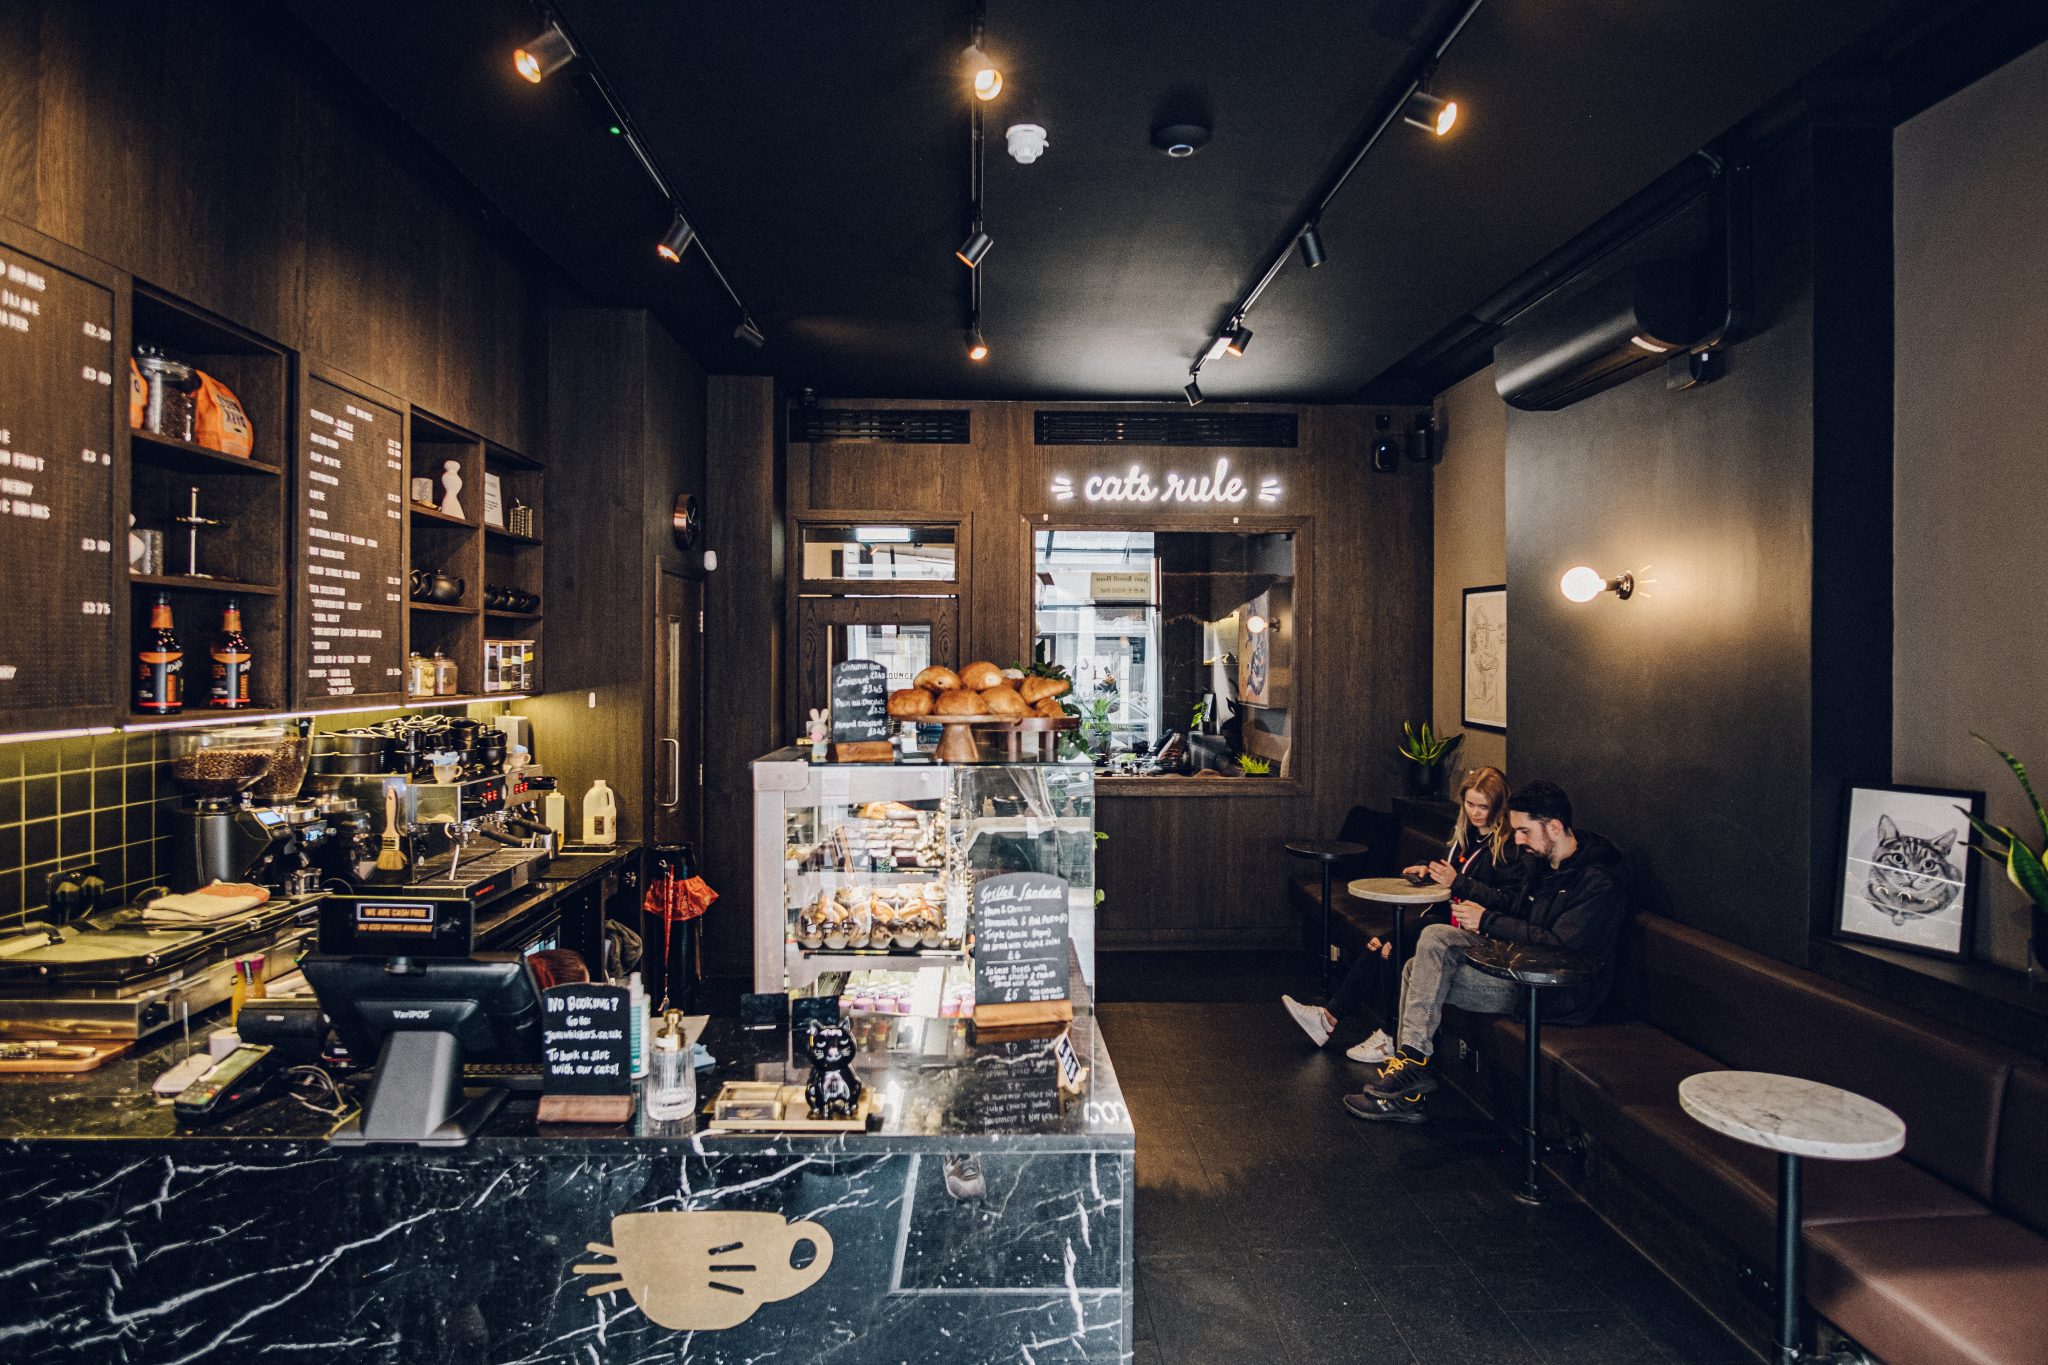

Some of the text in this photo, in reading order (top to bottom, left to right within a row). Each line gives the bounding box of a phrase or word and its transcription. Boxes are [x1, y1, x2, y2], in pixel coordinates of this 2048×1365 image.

[1085, 457, 1247, 502] cats rule
[886, 672, 914, 680] OUNGE
[392, 1009, 432, 1020] VariPOS
[565, 1015, 578, 1027] Go
[545, 1047, 611, 1062] To book a slot
[551, 1062, 620, 1076] with our cats!
